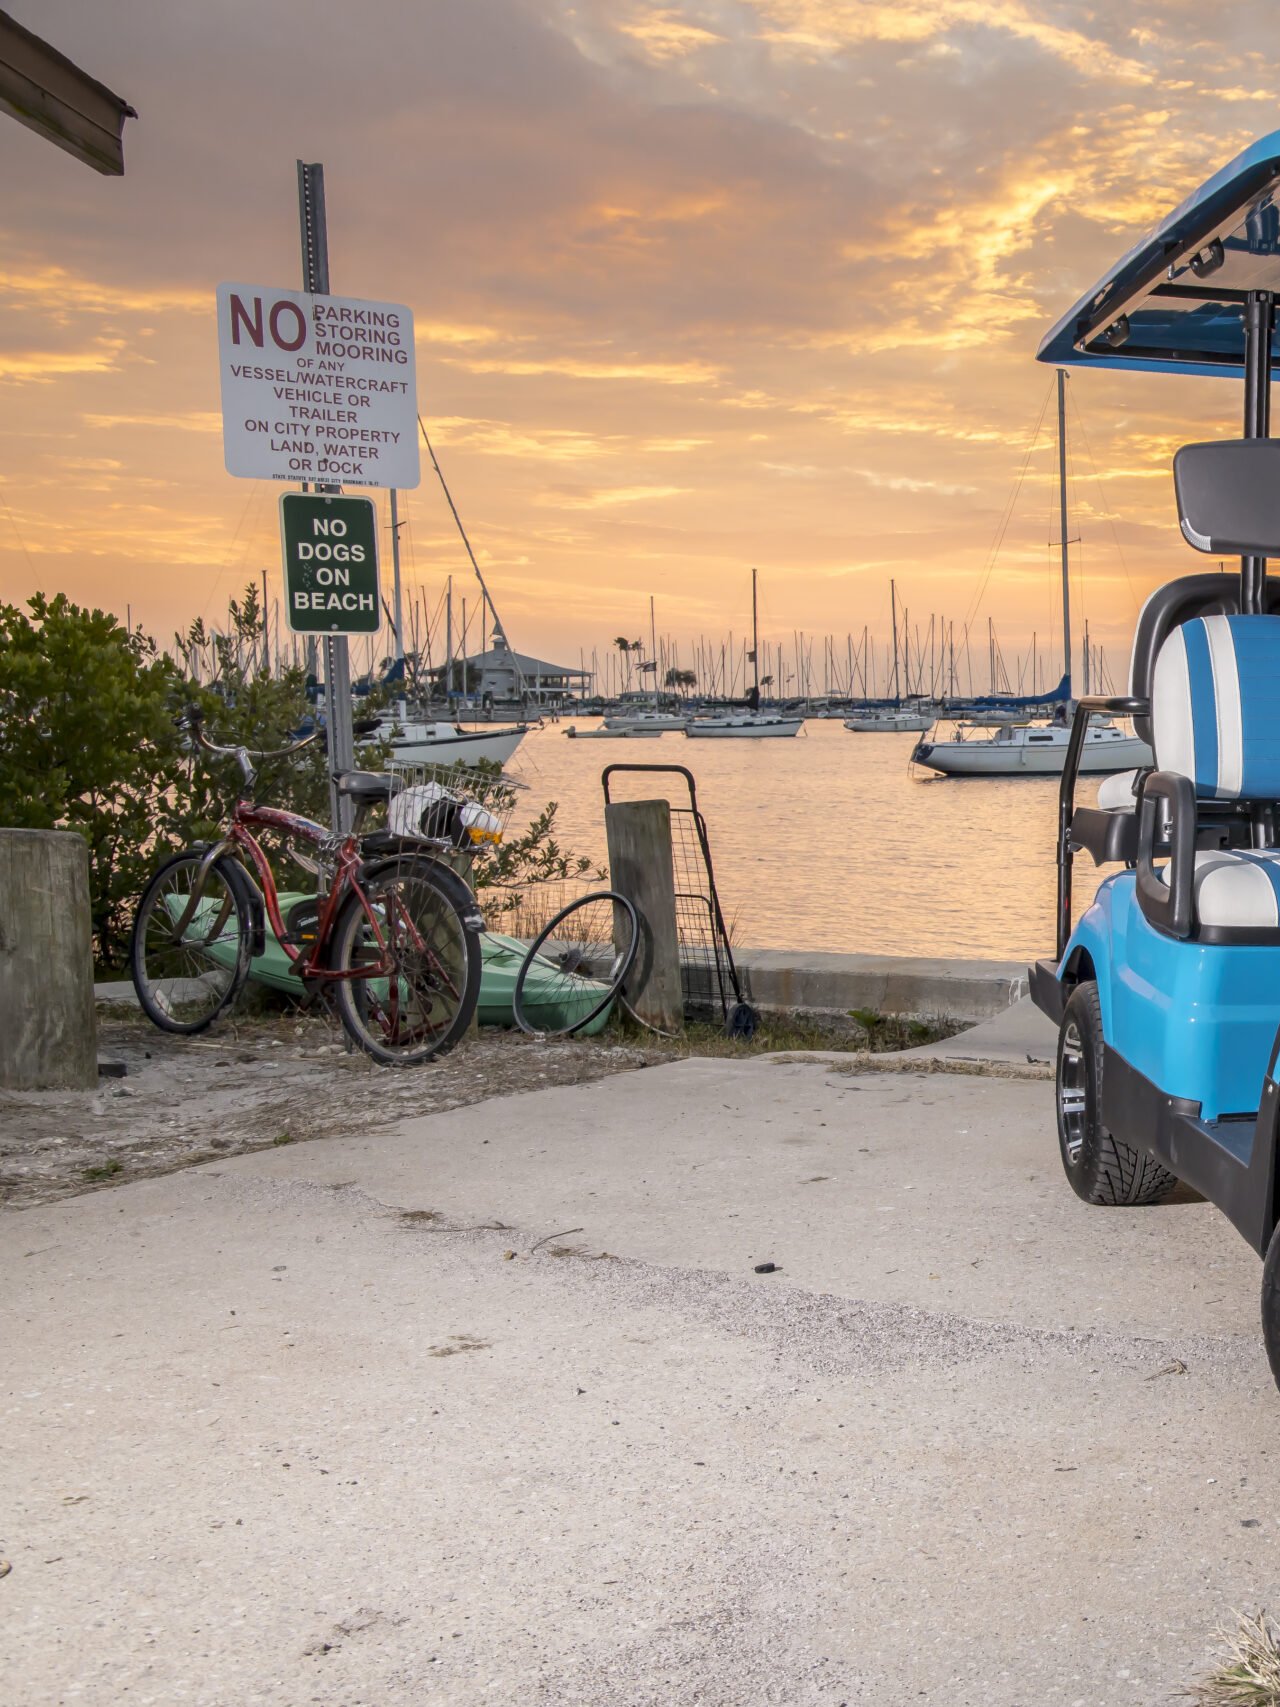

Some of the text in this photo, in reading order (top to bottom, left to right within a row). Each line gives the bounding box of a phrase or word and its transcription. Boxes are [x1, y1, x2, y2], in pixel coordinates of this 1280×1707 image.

[230, 294, 307, 352] NO
[314, 304, 400, 328] PARKING
[315, 323, 400, 345] STORING
[316, 341, 408, 364] MOORING
[296, 358, 345, 372] OF ANY
[230, 364, 408, 394] VESSEL/WATERCRAFT
[273, 386, 371, 407] VEHICLE OR
[289, 405, 357, 423] TRAILER
[244, 419, 400, 444] ON CITY PROPERTY
[270, 439, 379, 459] LAND, WATER
[288, 458, 363, 475] OR DOCK
[313, 518, 347, 537] NO
[298, 542, 366, 562] DOGS
[316, 568, 350, 586] ON
[294, 591, 374, 611] BEACH
